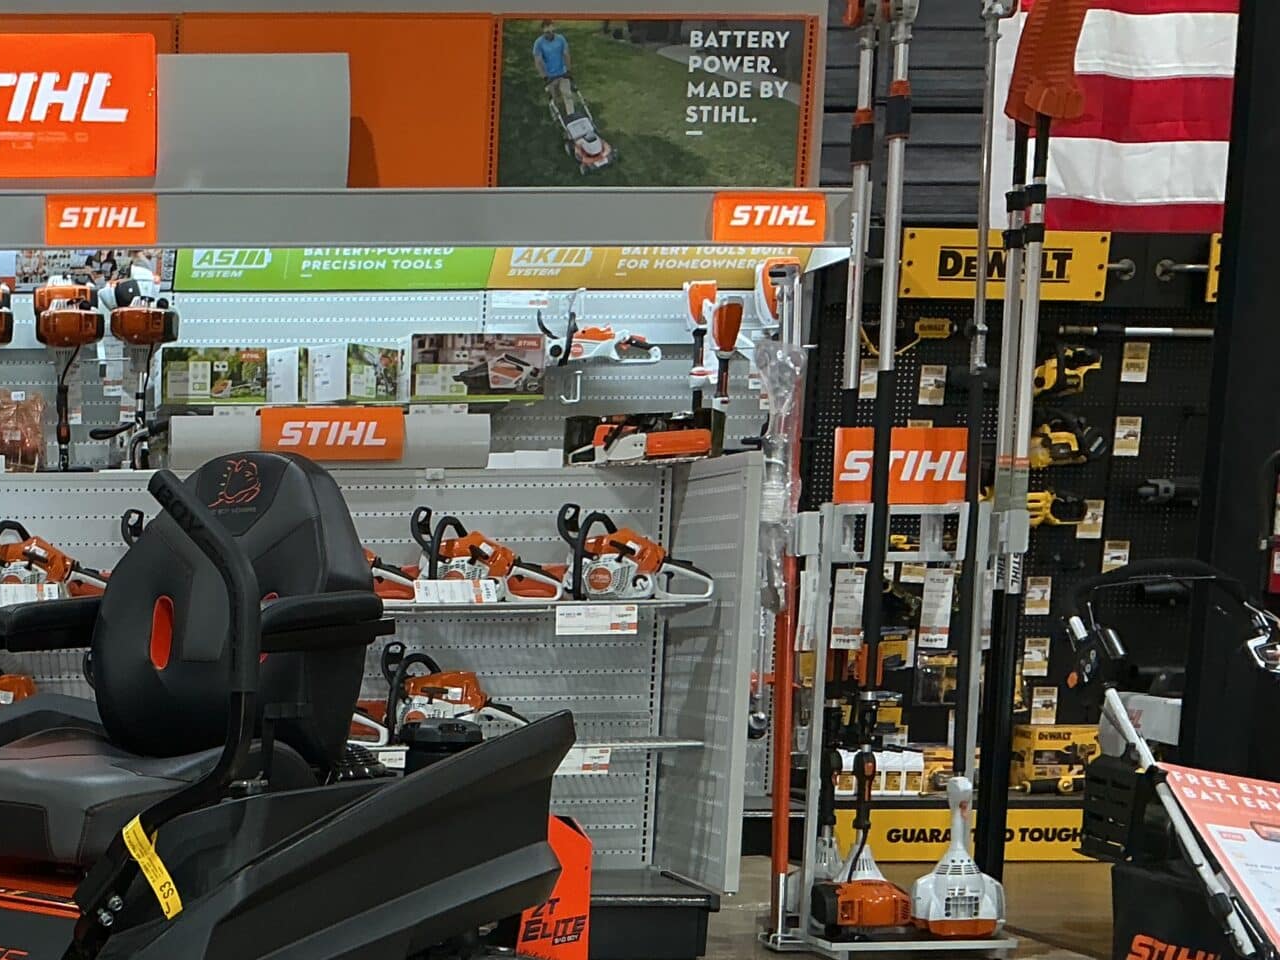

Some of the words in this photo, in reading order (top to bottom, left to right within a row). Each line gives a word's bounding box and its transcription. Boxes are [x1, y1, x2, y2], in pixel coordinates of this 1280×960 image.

[690, 31, 790, 49] BATTERY
[688, 56, 777, 73] POWER.
[687, 81, 752, 98] MADE
[759, 81, 789, 98] BY
[685, 105, 757, 123] STIHL.
[58, 206, 146, 228] STIHL
[730, 205, 816, 227] STIHL
[303, 247, 454, 257] BATTERY-POWERED
[621, 247, 690, 256] BATTERY
[301, 259, 387, 270] PRECISION
[391, 259, 444, 270] TOOLS
[507, 268, 561, 276] SYSTEM
[618, 258, 650, 270] FOR
[191, 270, 244, 278] SYSTEM
[278, 421, 387, 446] STIHL
[840, 450, 967, 482] STIHL
[1170, 770, 1231, 791] FREE
[522, 915, 587, 942] ELITE
